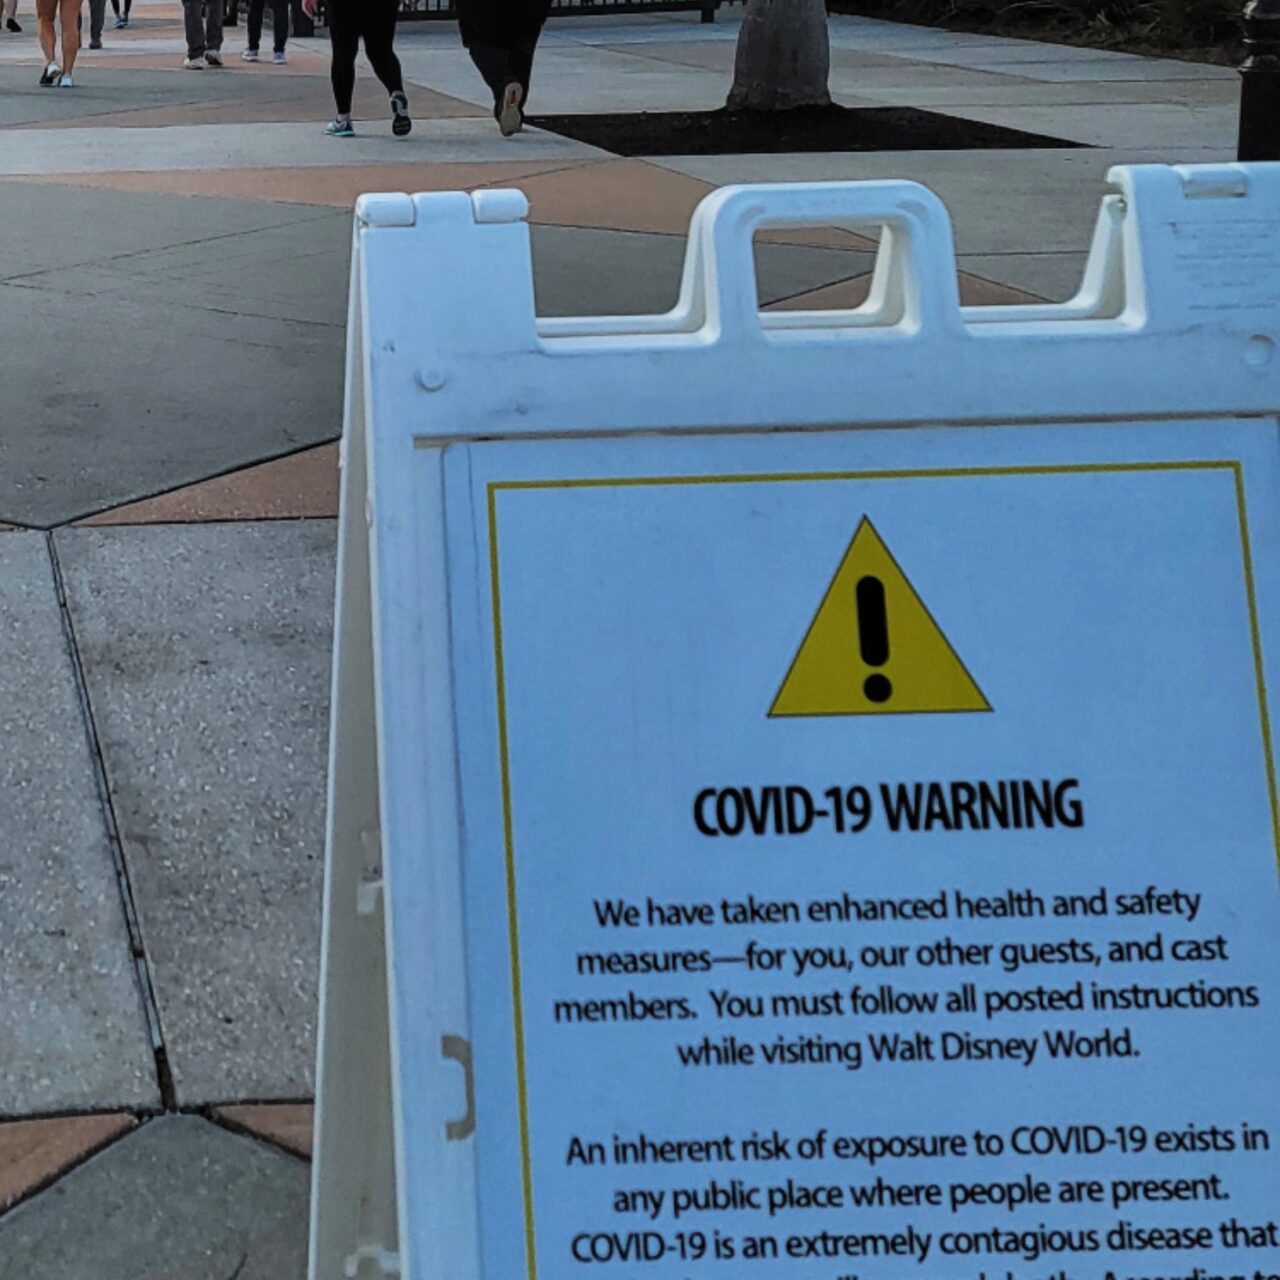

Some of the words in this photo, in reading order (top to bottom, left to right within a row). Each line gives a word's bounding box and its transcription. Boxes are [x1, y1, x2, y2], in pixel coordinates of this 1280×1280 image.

[694, 785, 872, 837] COVID-19
[878, 778, 1085, 833] WARNING
[593, 899, 641, 928] We
[646, 897, 715, 927] have
[720, 895, 801, 925] taken
[807, 890, 949, 923] enhanced
[954, 888, 1046, 919] health
[1052, 886, 1108, 917] and
[1115, 885, 1201, 922] safety
[792, 946, 854, 978] you,
[860, 946, 910, 969] our
[915, 936, 994, 967] other
[999, 938, 1102, 973] guests,
[1108, 932, 1164, 963] and
[1170, 934, 1229, 962] cast
[554, 991, 698, 1023] members.
[708, 989, 764, 1018] You
[771, 990, 844, 1017] must
[849, 985, 939, 1015] follow
[945, 983, 977, 1013] all
[984, 981, 1085, 1020] posted
[1090, 979, 1260, 1010] instructions
[676, 1035, 755, 1067] while
[760, 1034, 862, 1071] visiting
[868, 1032, 935, 1063] Walt
[941, 1030, 1038, 1067] Disney
[1043, 1027, 1141, 1060] World.
[566, 1136, 606, 1166] An
[613, 1133, 736, 1164] inherent
[741, 1131, 792, 1162] risk
[796, 1128, 827, 1160] of
[832, 1134, 968, 1167] exposure
[973, 1129, 1005, 1157] to
[1010, 1125, 1148, 1156] COVID-19
[1154, 1122, 1236, 1153] exists
[1241, 1122, 1270, 1151] in
[613, 1190, 665, 1221] any
[672, 1180, 762, 1219] public
[767, 1178, 844, 1217] place
[849, 1176, 943, 1207] where
[949, 1173, 1052, 1214] people
[1058, 1180, 1105, 1204] are
[1111, 1173, 1230, 1210] present.
[570, 1231, 707, 1264] COVID-19
[713, 1229, 736, 1260] is
[741, 1236, 779, 1260] an
[785, 1224, 933, 1264] extremely
[938, 1223, 1101, 1262] contagious
[1106, 1220, 1213, 1252] disease
[1219, 1217, 1280, 1249] that
